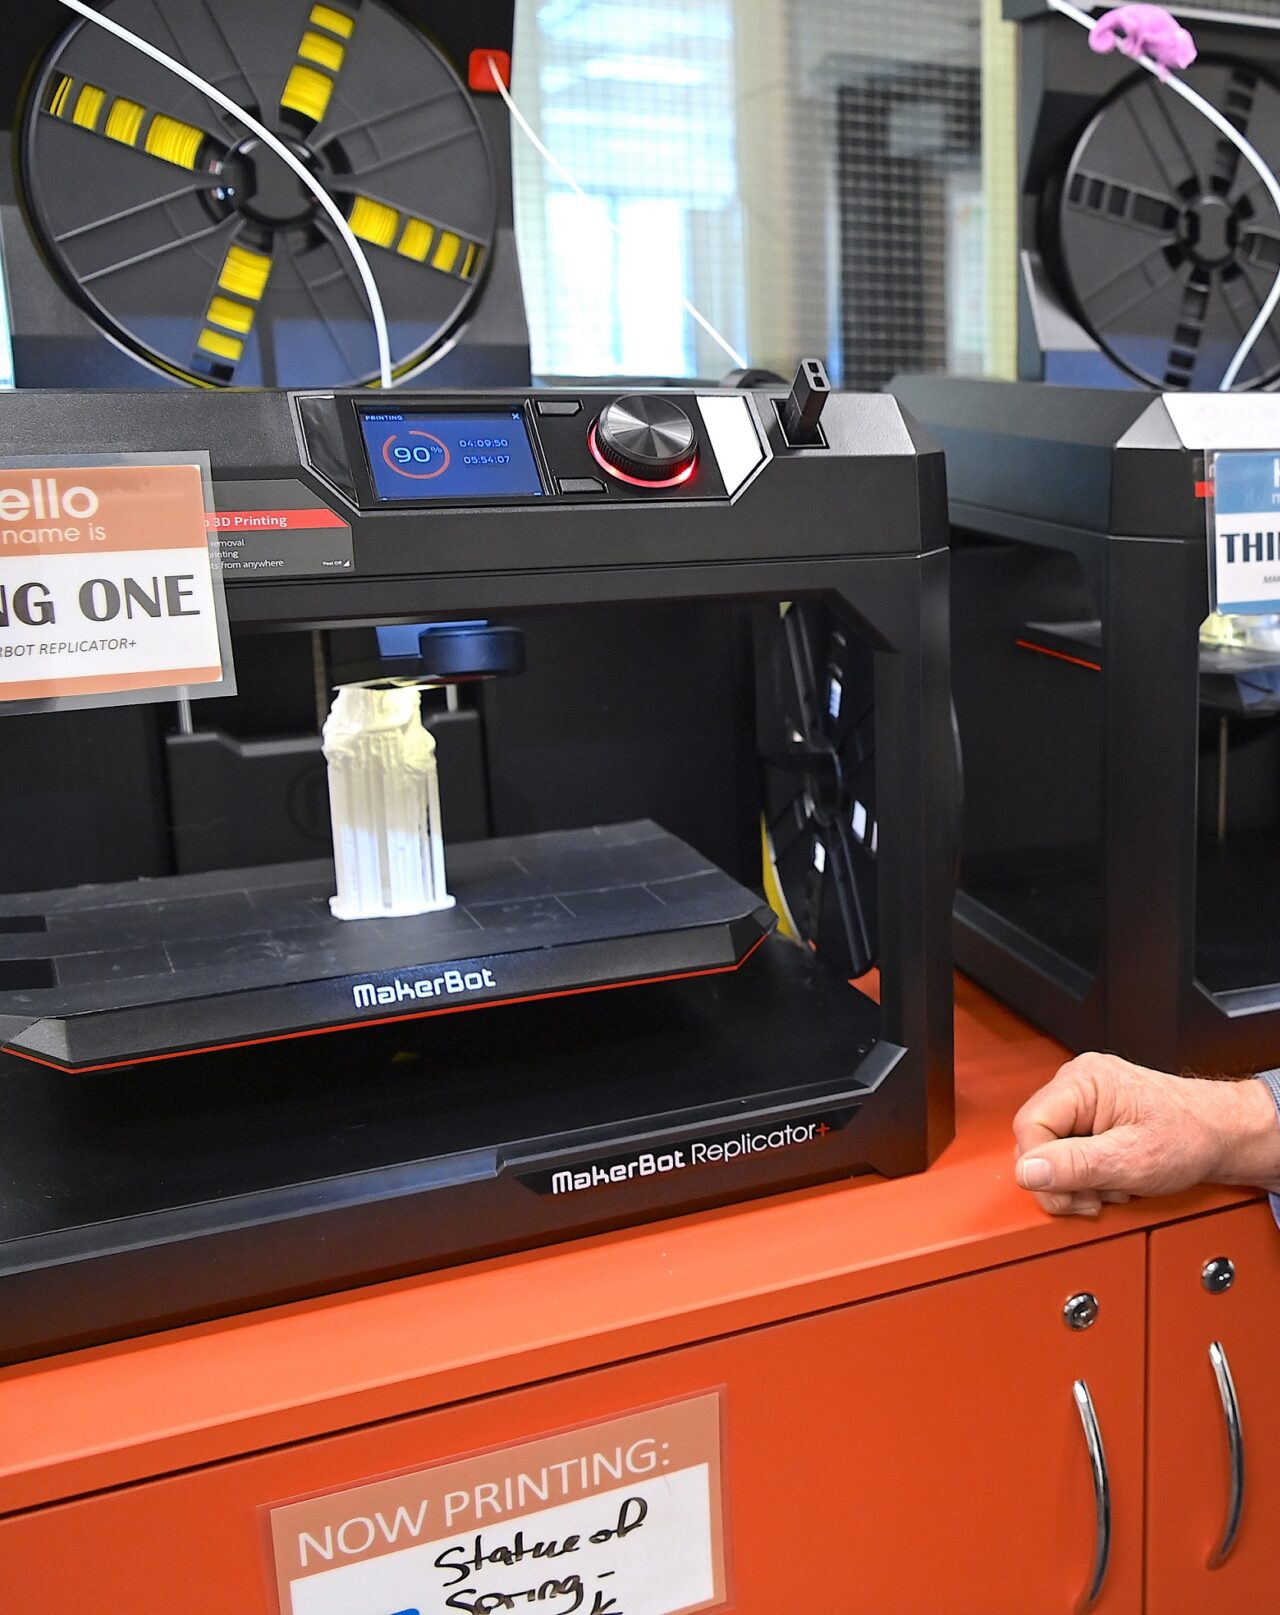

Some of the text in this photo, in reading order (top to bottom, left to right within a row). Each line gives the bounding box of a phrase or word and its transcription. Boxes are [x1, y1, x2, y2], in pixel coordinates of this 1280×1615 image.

[459, 439, 508, 448] 04:09:50
[463, 455, 510, 464] 05:54:07
[213, 517, 231, 527] 3D
[234, 515, 287, 528] Printing
[3, 523, 107, 545] name is
[210, 538, 245, 548] removal
[221, 560, 241, 569] from
[243, 559, 284, 570] anywhere
[0, 574, 200, 627] G ONE
[40, 638, 137, 656] REPLICATOR+
[353, 968, 496, 1008] MakerBot
[552, 1122, 830, 1195] MakerBot Replicator+
[297, 1438, 670, 1567] NOW PRINTING:
[434, 1531, 580, 1587] Statue
